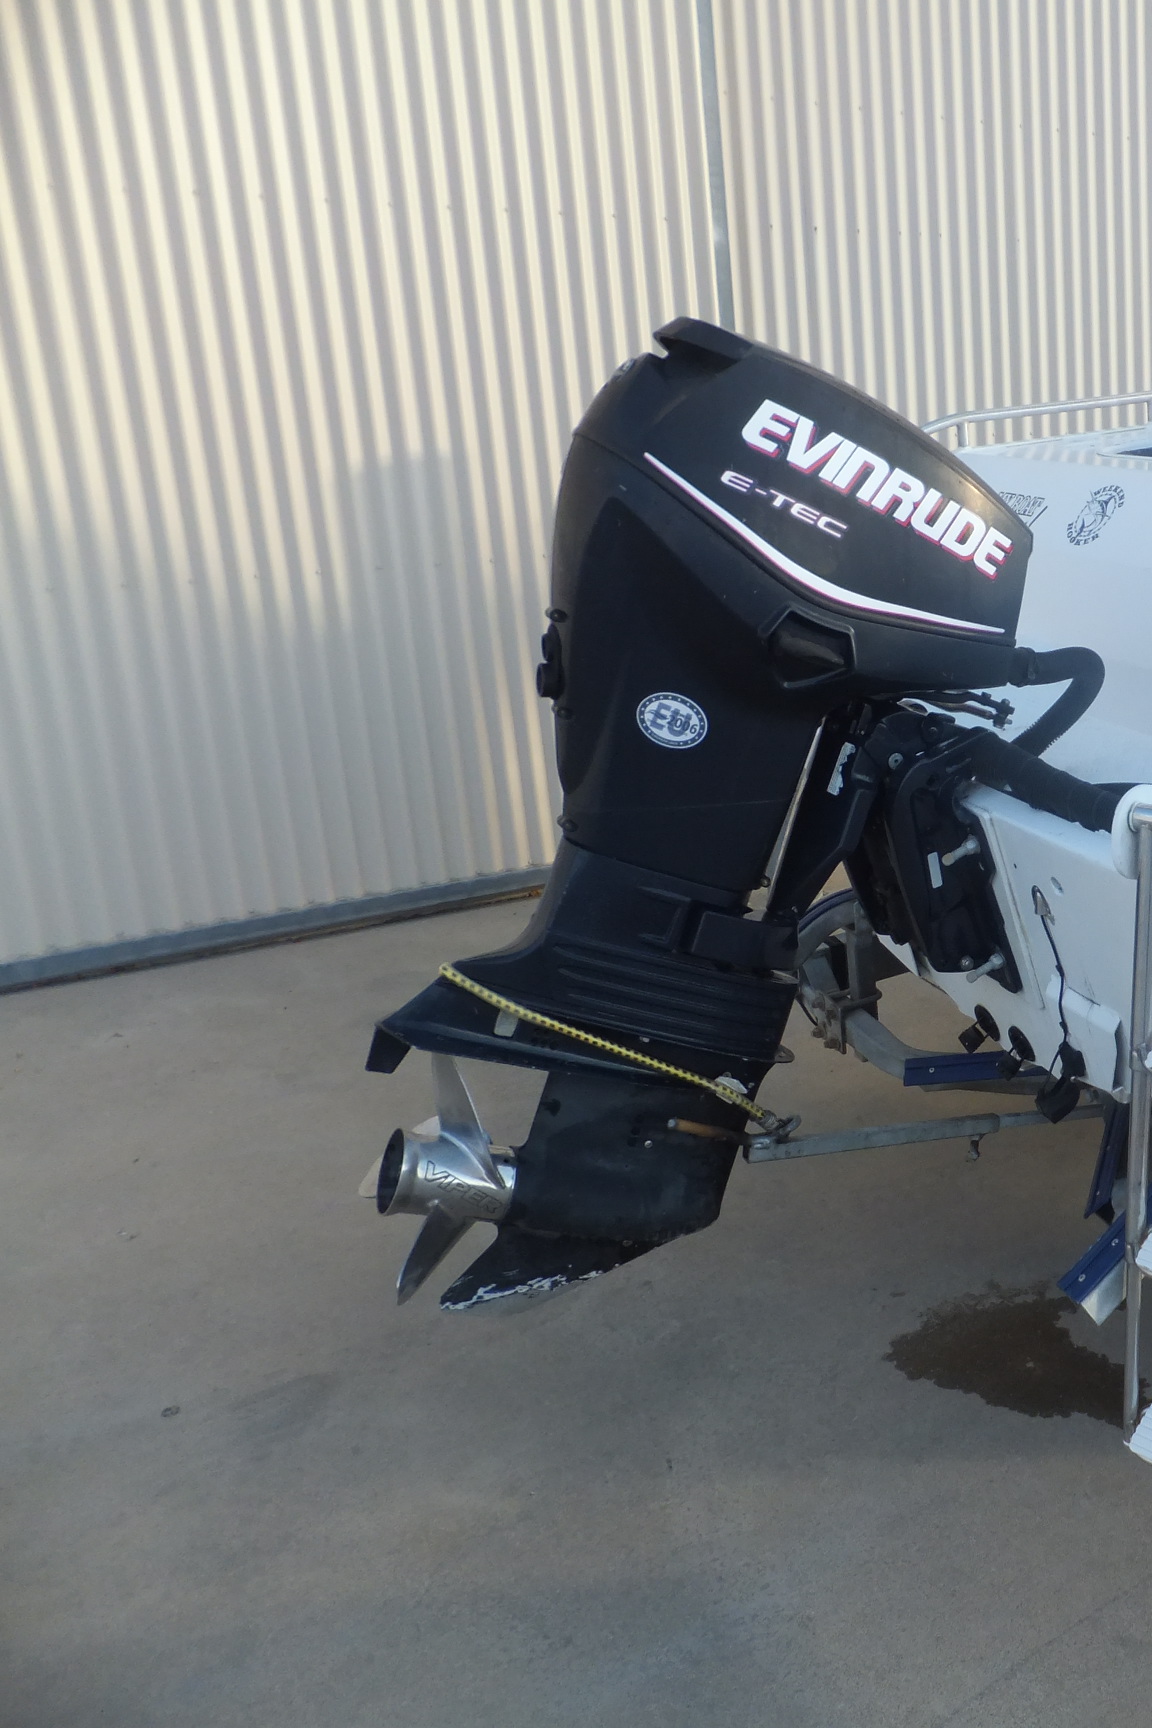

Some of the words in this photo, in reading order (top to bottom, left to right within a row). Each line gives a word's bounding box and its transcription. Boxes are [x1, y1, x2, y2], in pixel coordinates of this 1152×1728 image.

[720, 470, 848, 539] E-TEC
[741, 399, 1014, 580] EVINRUDE
[1093, 485, 1126, 508] WEEKEND
[1066, 523, 1099, 546] HOOKER
[424, 1160, 503, 1214] VIPER
